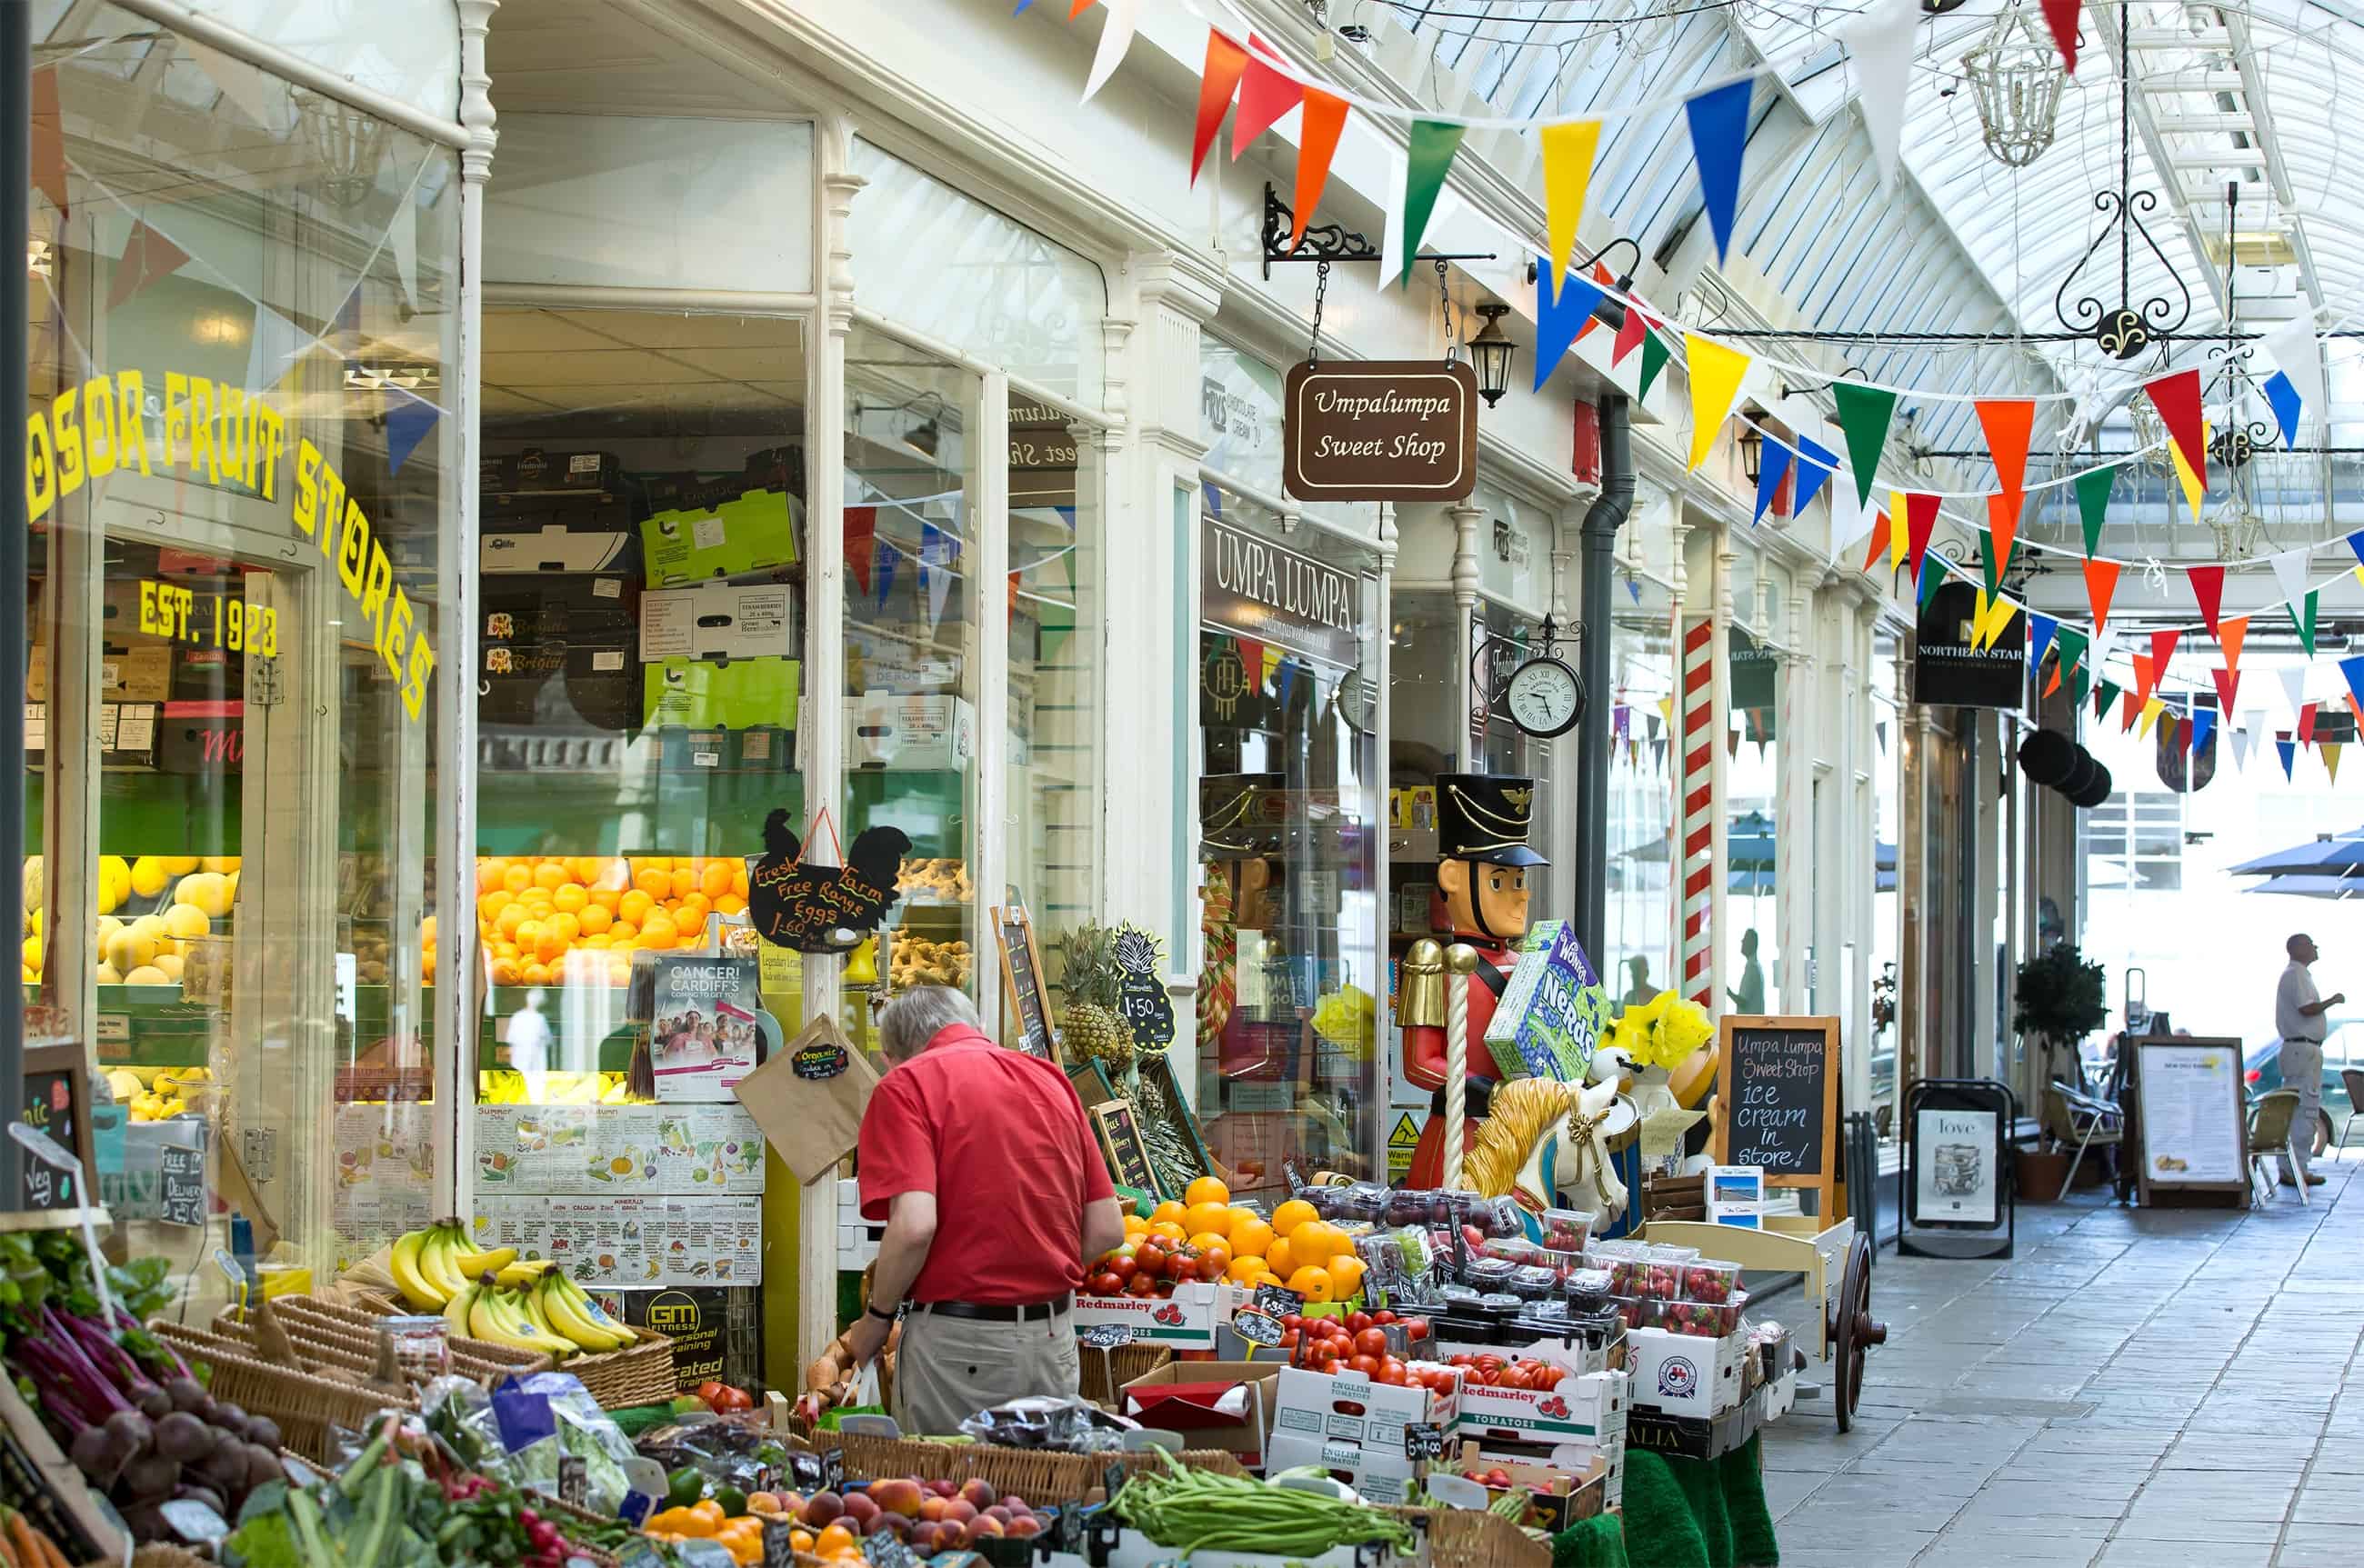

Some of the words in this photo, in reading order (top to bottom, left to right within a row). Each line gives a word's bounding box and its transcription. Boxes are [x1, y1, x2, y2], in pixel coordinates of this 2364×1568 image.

[1315, 388, 1451, 422] Umpalumpa
[1315, 434, 1384, 459] Sweet
[1388, 432, 1447, 464] Shop
[165, 370, 285, 501] FRUIT
[293, 437, 435, 723] STORES
[1213, 528, 1280, 608] UMPA
[1284, 555, 1353, 634] LUMPA
[140, 580, 200, 643] EST.
[214, 596, 277, 658] 1923
[1990, 648, 2023, 661] STAR
[754, 856, 799, 884] Fresh
[839, 866, 885, 903] Farm
[777, 880, 813, 897] Free
[818, 880, 865, 916] Range
[794, 900, 837, 925] Eggs
[671, 966, 740, 981] CANCER!
[671, 980, 740, 993] CARDIFF'S
[1738, 1034, 1780, 1061] Umpa
[1784, 1034, 1823, 1062] Lumpa
[1742, 1057, 1784, 1080] Sweet
[1785, 1057, 1818, 1084] Shop
[1076, 1299, 1152, 1313] Redmarley
[651, 1323, 696, 1332] FITNESS
[1331, 1381, 1371, 1394] ENGLISH
[1460, 1385, 1538, 1403] Redmarley
[1474, 1414, 1537, 1430] TOMATOES
[1321, 1456, 1360, 1467] TOMATOES
[1322, 1446, 1361, 1460] ENGLISH
